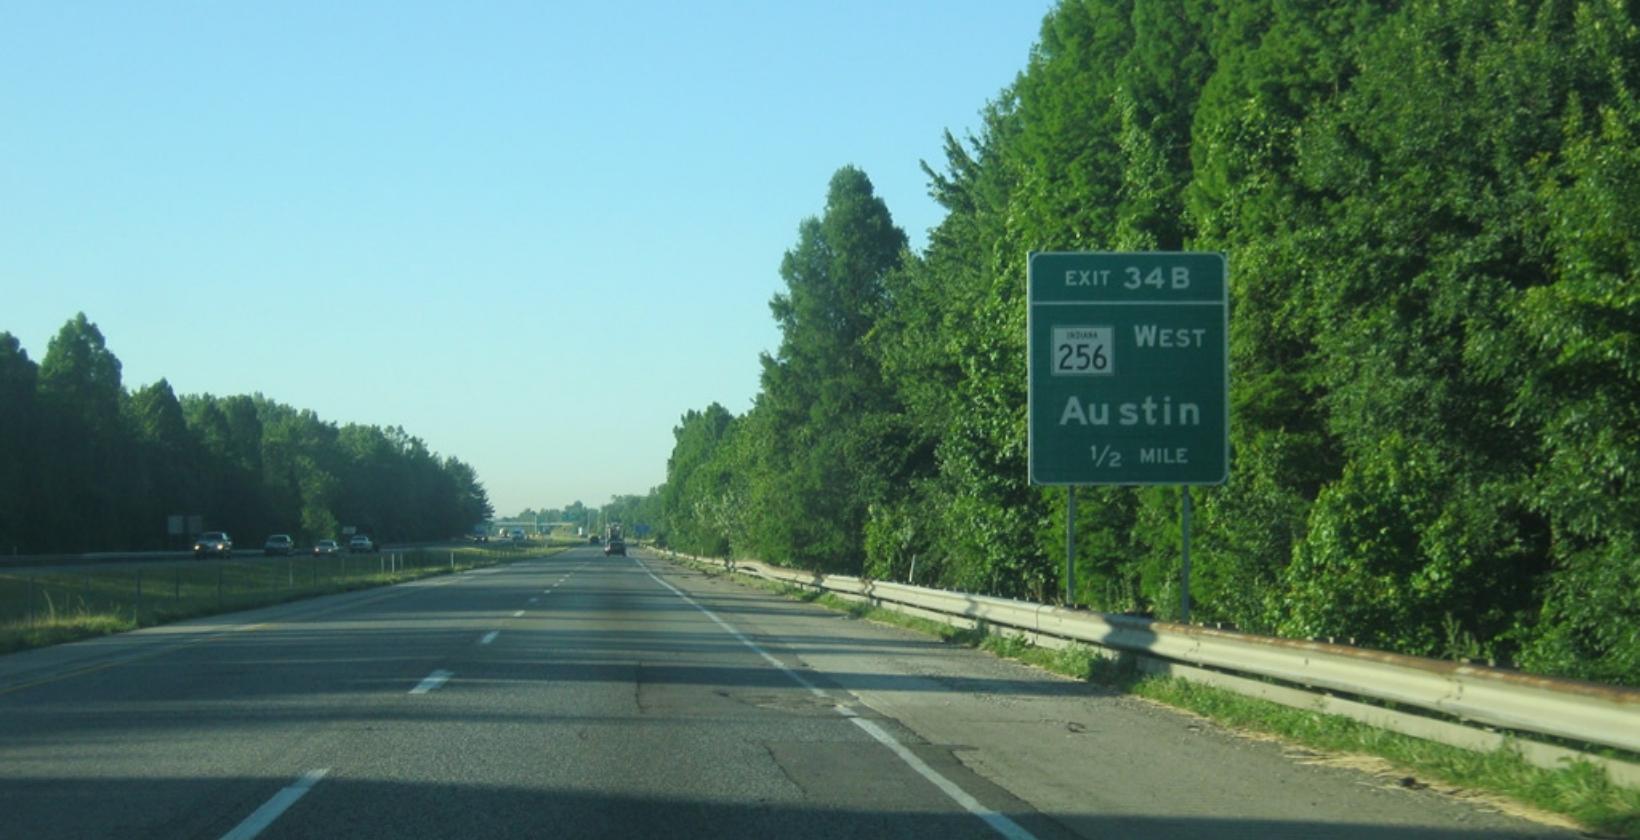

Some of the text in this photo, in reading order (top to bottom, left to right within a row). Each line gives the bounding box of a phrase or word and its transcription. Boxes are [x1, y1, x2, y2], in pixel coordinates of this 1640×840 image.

[1065, 266, 1190, 289] EXIT 34B
[1066, 331, 1099, 340] INDIANA
[1133, 325, 1206, 348] WEST
[1058, 343, 1108, 371] 256
[1059, 395, 1200, 426] Austin
[1139, 448, 1189, 464] MILE
